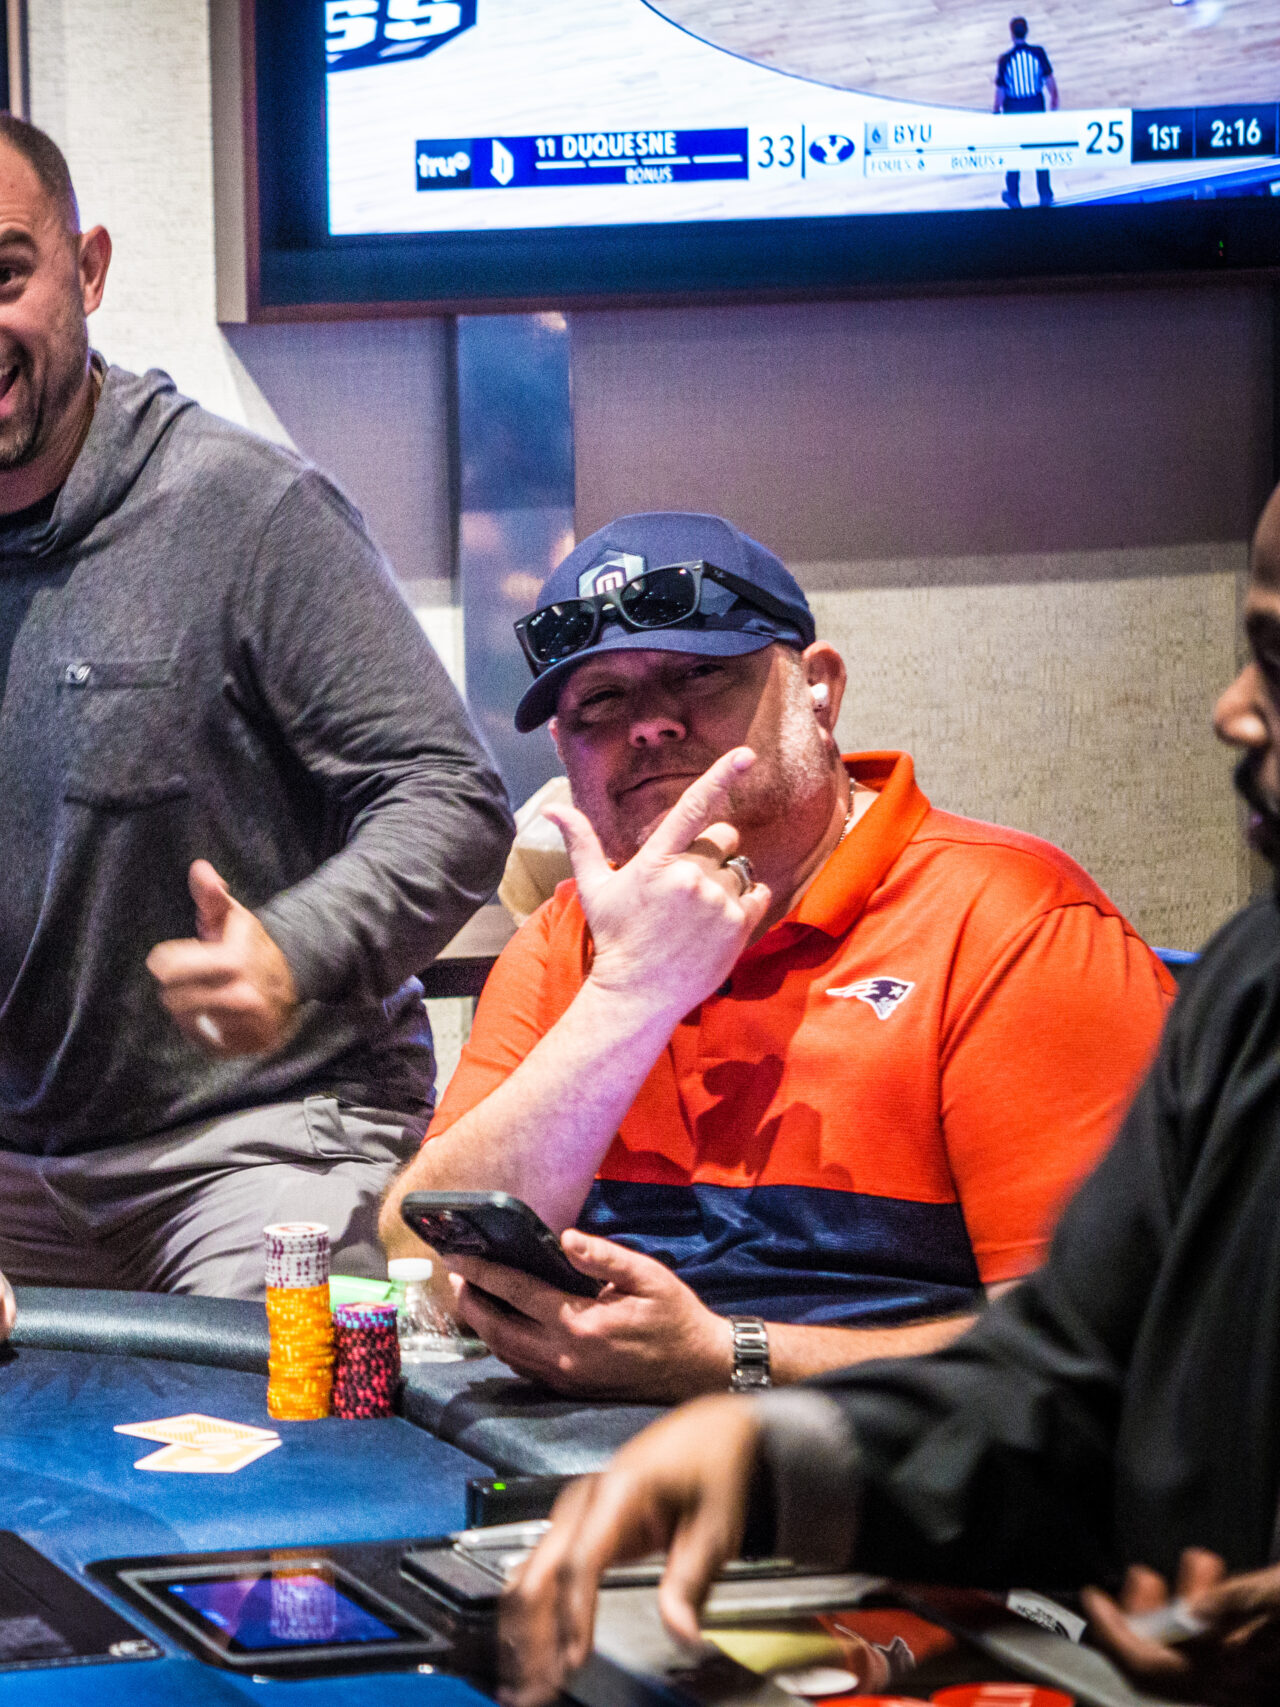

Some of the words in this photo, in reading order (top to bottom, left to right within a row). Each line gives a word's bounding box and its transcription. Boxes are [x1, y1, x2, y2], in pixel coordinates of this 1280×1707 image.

[536, 138, 556, 158] 11
[562, 132, 677, 158] DUQUESNE
[894, 123, 932, 144] BYU
[1085, 121, 1125, 154] 25
[1148, 123, 1182, 151] 1ST
[1210, 118, 1262, 148] 2:16
[757, 135, 795, 168] 33
[951, 155, 995, 169] BONUS
[625, 166, 673, 184] BONUS
